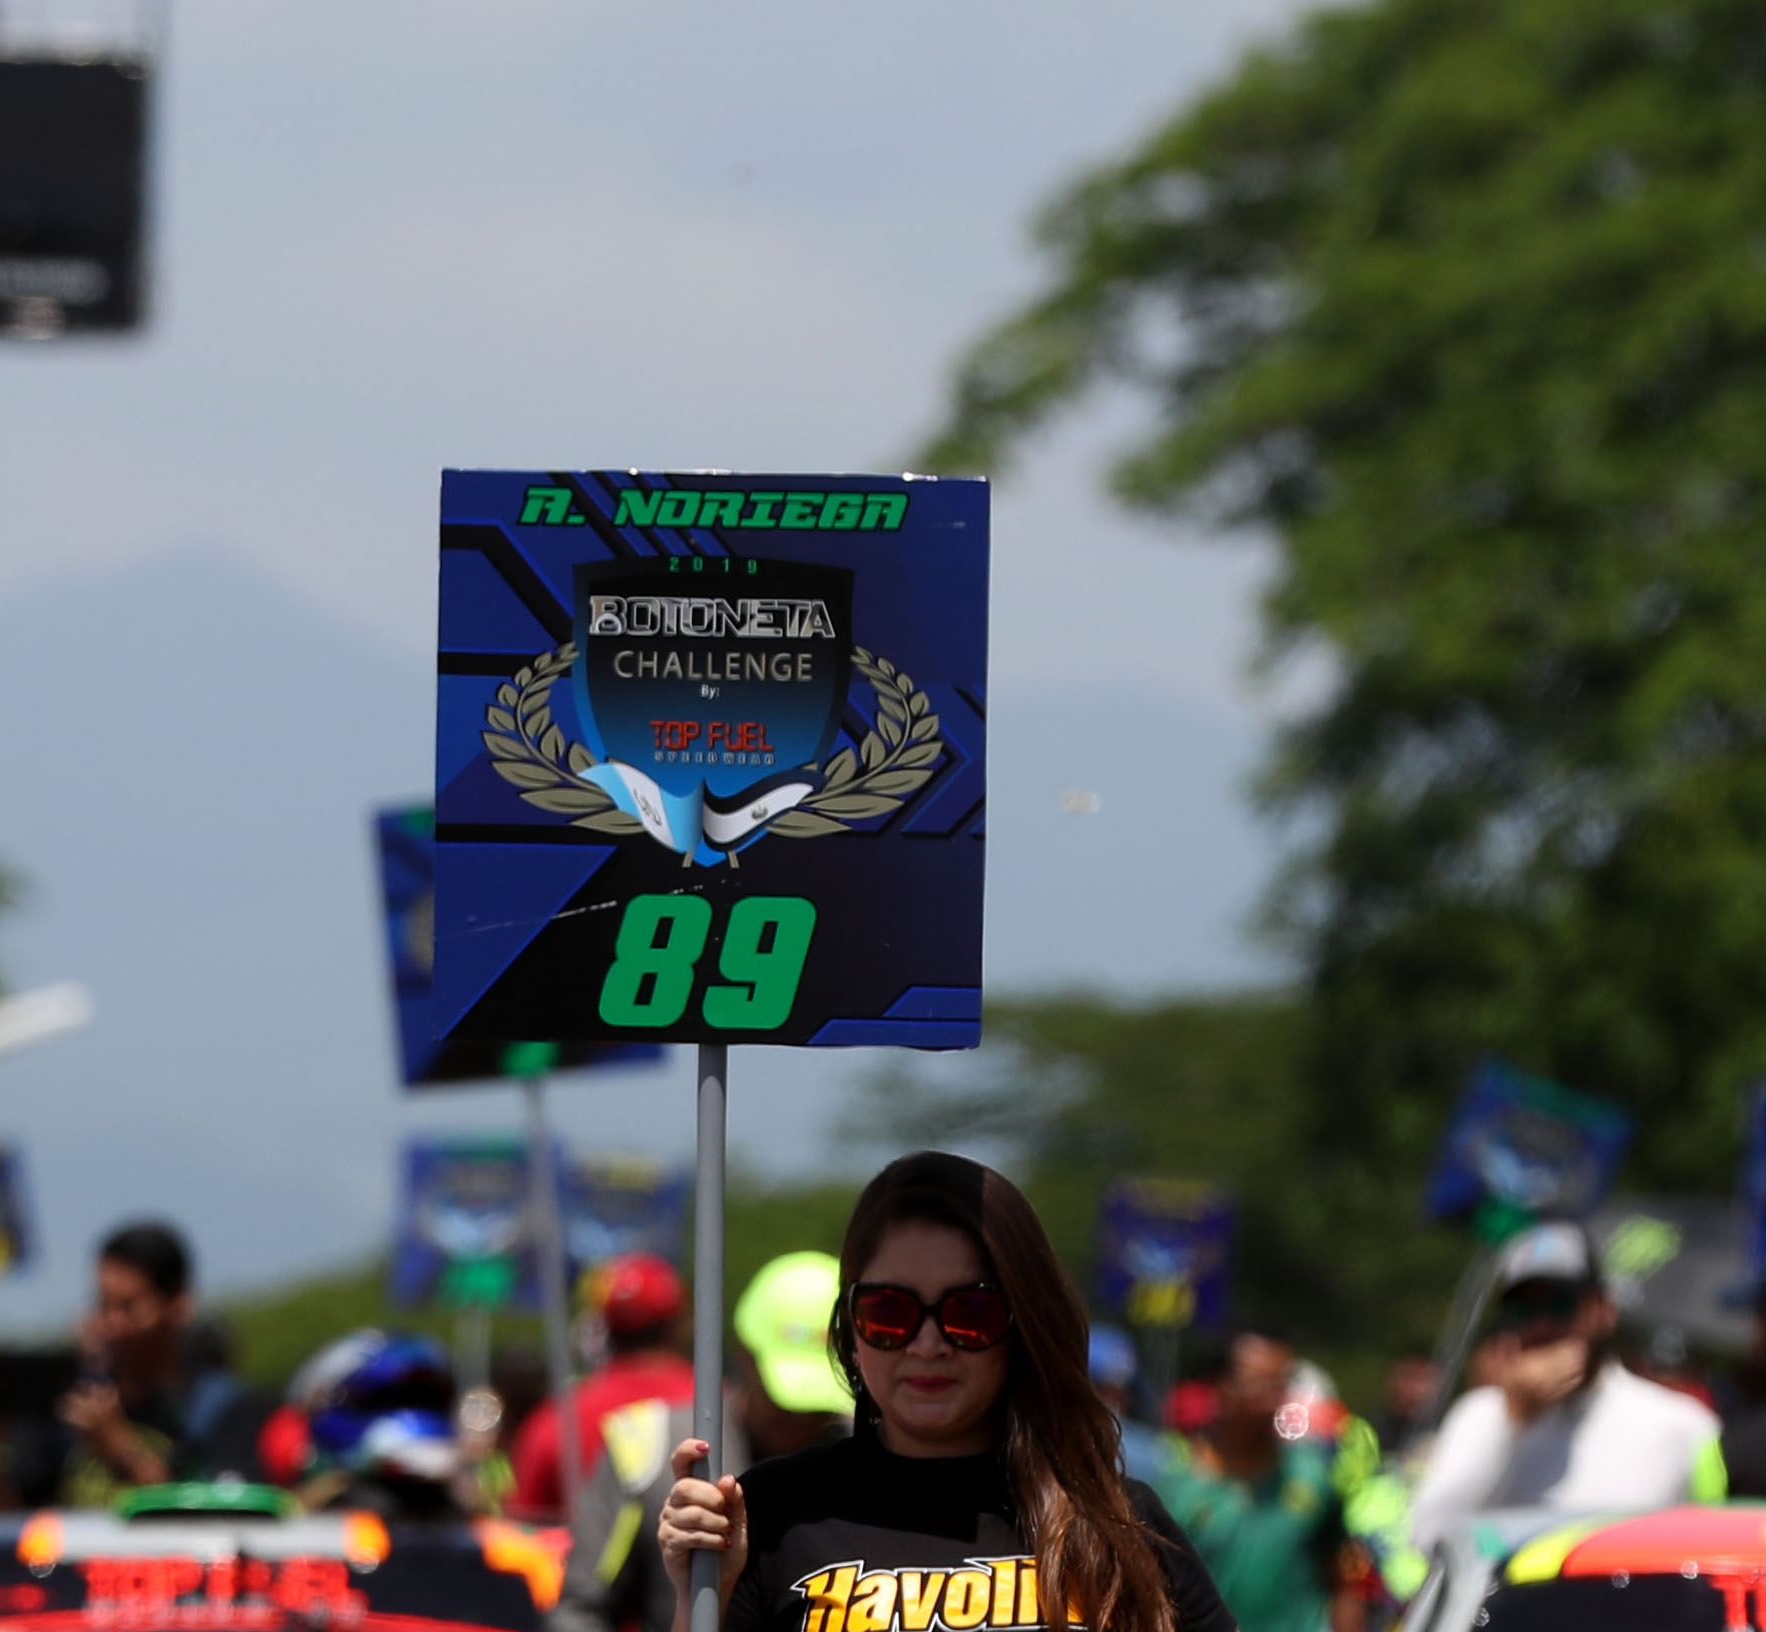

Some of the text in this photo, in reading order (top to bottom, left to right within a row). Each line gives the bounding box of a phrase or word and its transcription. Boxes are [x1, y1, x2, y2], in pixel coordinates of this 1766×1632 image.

[519, 487, 909, 530] A. NORIEGA
[669, 556, 757, 574] 2019
[589, 595, 836, 638] BOTONETA
[614, 650, 814, 682] CHALLENGE
[649, 720, 775, 752] TOP FUEL
[597, 894, 817, 1029] 89
